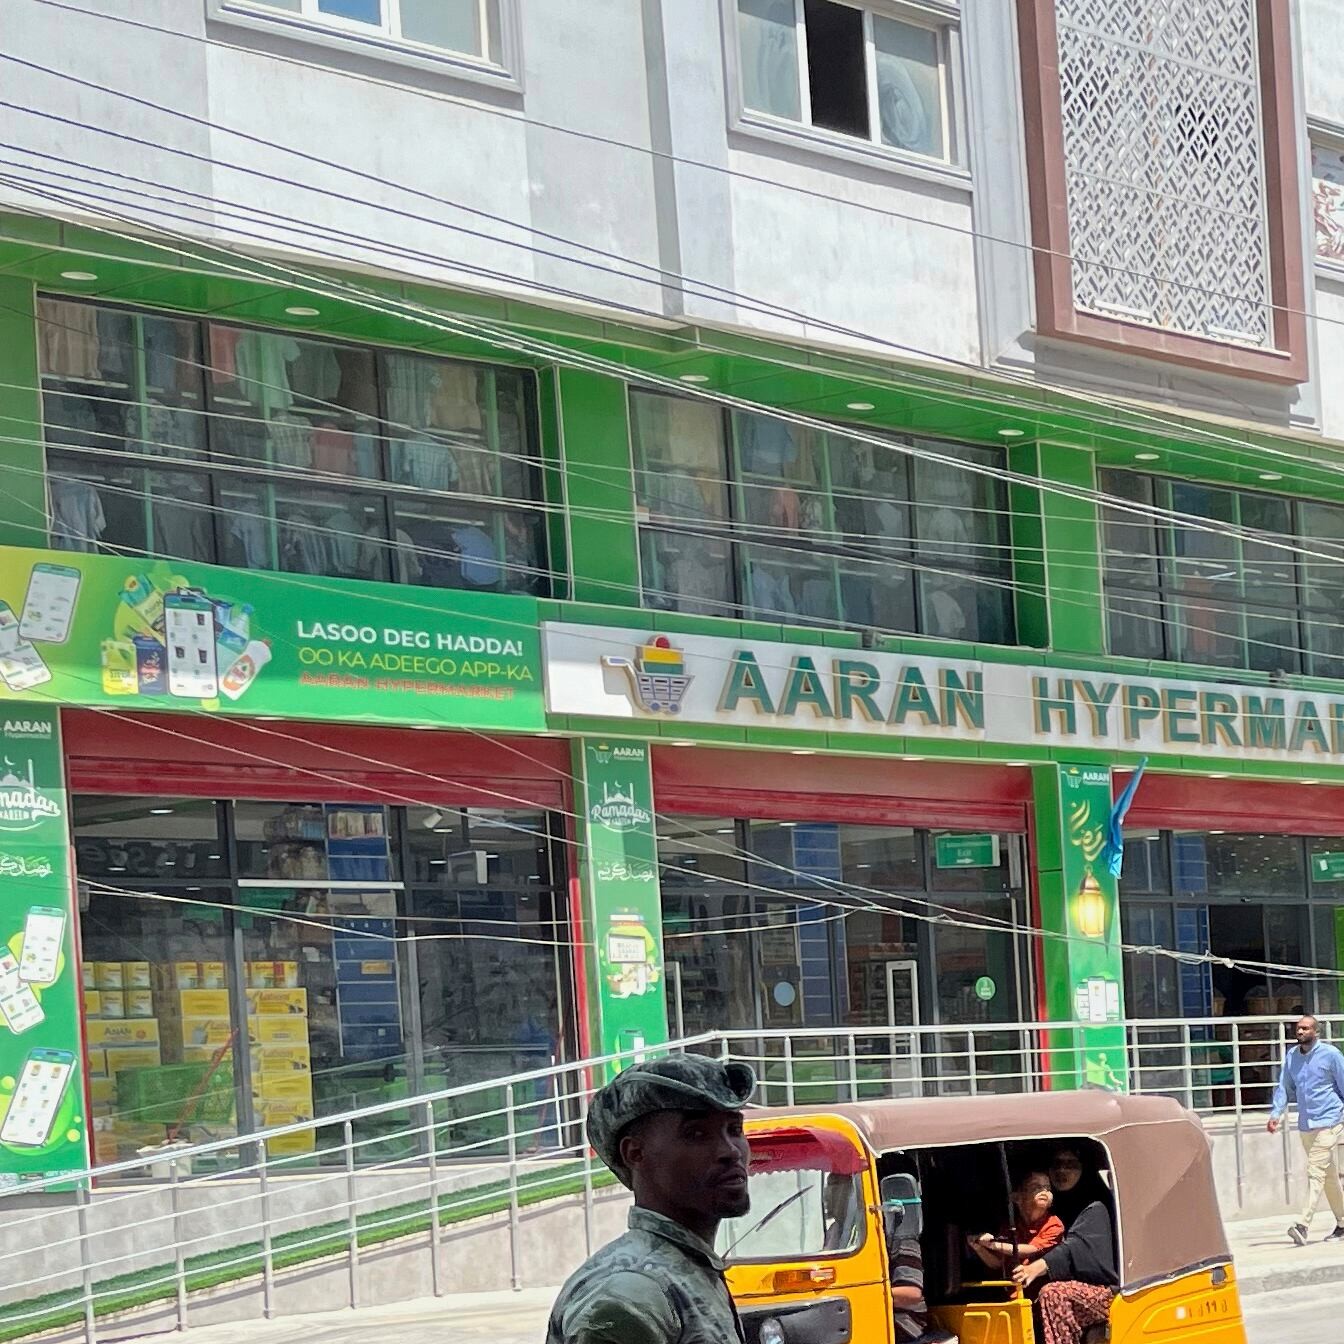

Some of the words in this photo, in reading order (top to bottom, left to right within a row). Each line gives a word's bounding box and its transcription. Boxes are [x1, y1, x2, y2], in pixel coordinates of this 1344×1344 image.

[297, 620, 378, 644] LASOO
[383, 628, 431, 649] DEG
[437, 633, 524, 657] HADDA!
[300, 647, 334, 665] OO
[338, 650, 368, 669] KA
[370, 653, 457, 676] ADEEGO
[459, 660, 534, 682] APP-KA
[717, 650, 985, 731] AARAN
[4, 720, 52, 733] AARAN
[613, 747, 645, 757] AARAN
[591, 803, 651, 825] Ramadan
